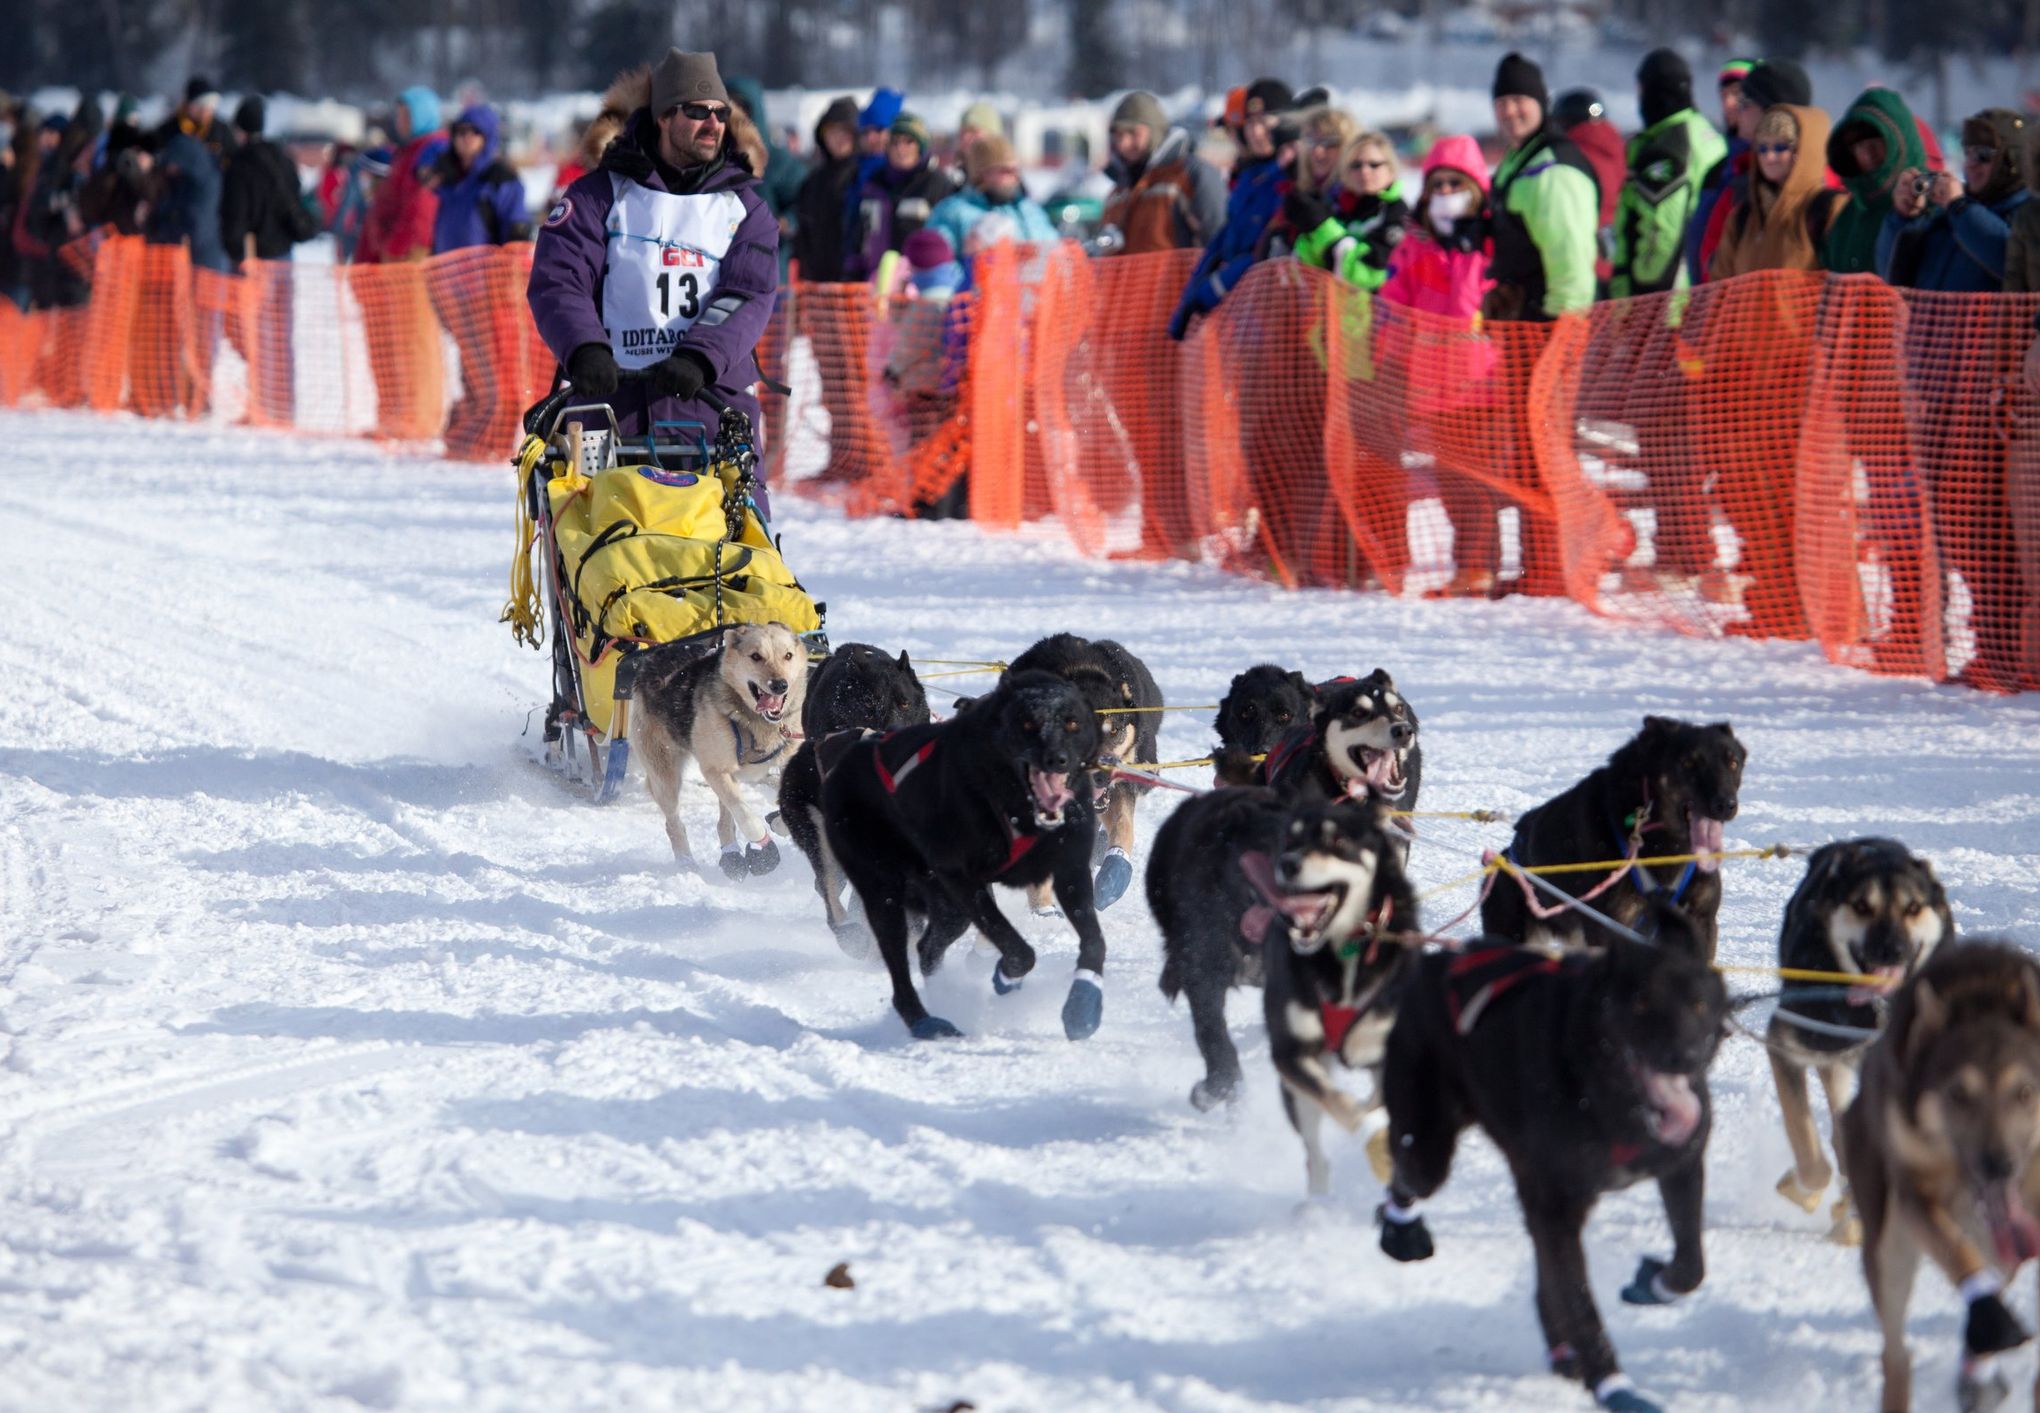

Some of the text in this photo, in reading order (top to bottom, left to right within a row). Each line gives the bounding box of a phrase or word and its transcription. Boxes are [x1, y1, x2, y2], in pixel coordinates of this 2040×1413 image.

[663, 247, 704, 267] GCI
[656, 272, 699, 319] 13
[622, 327, 686, 347] IDITARO
[656, 346, 674, 354] WI
